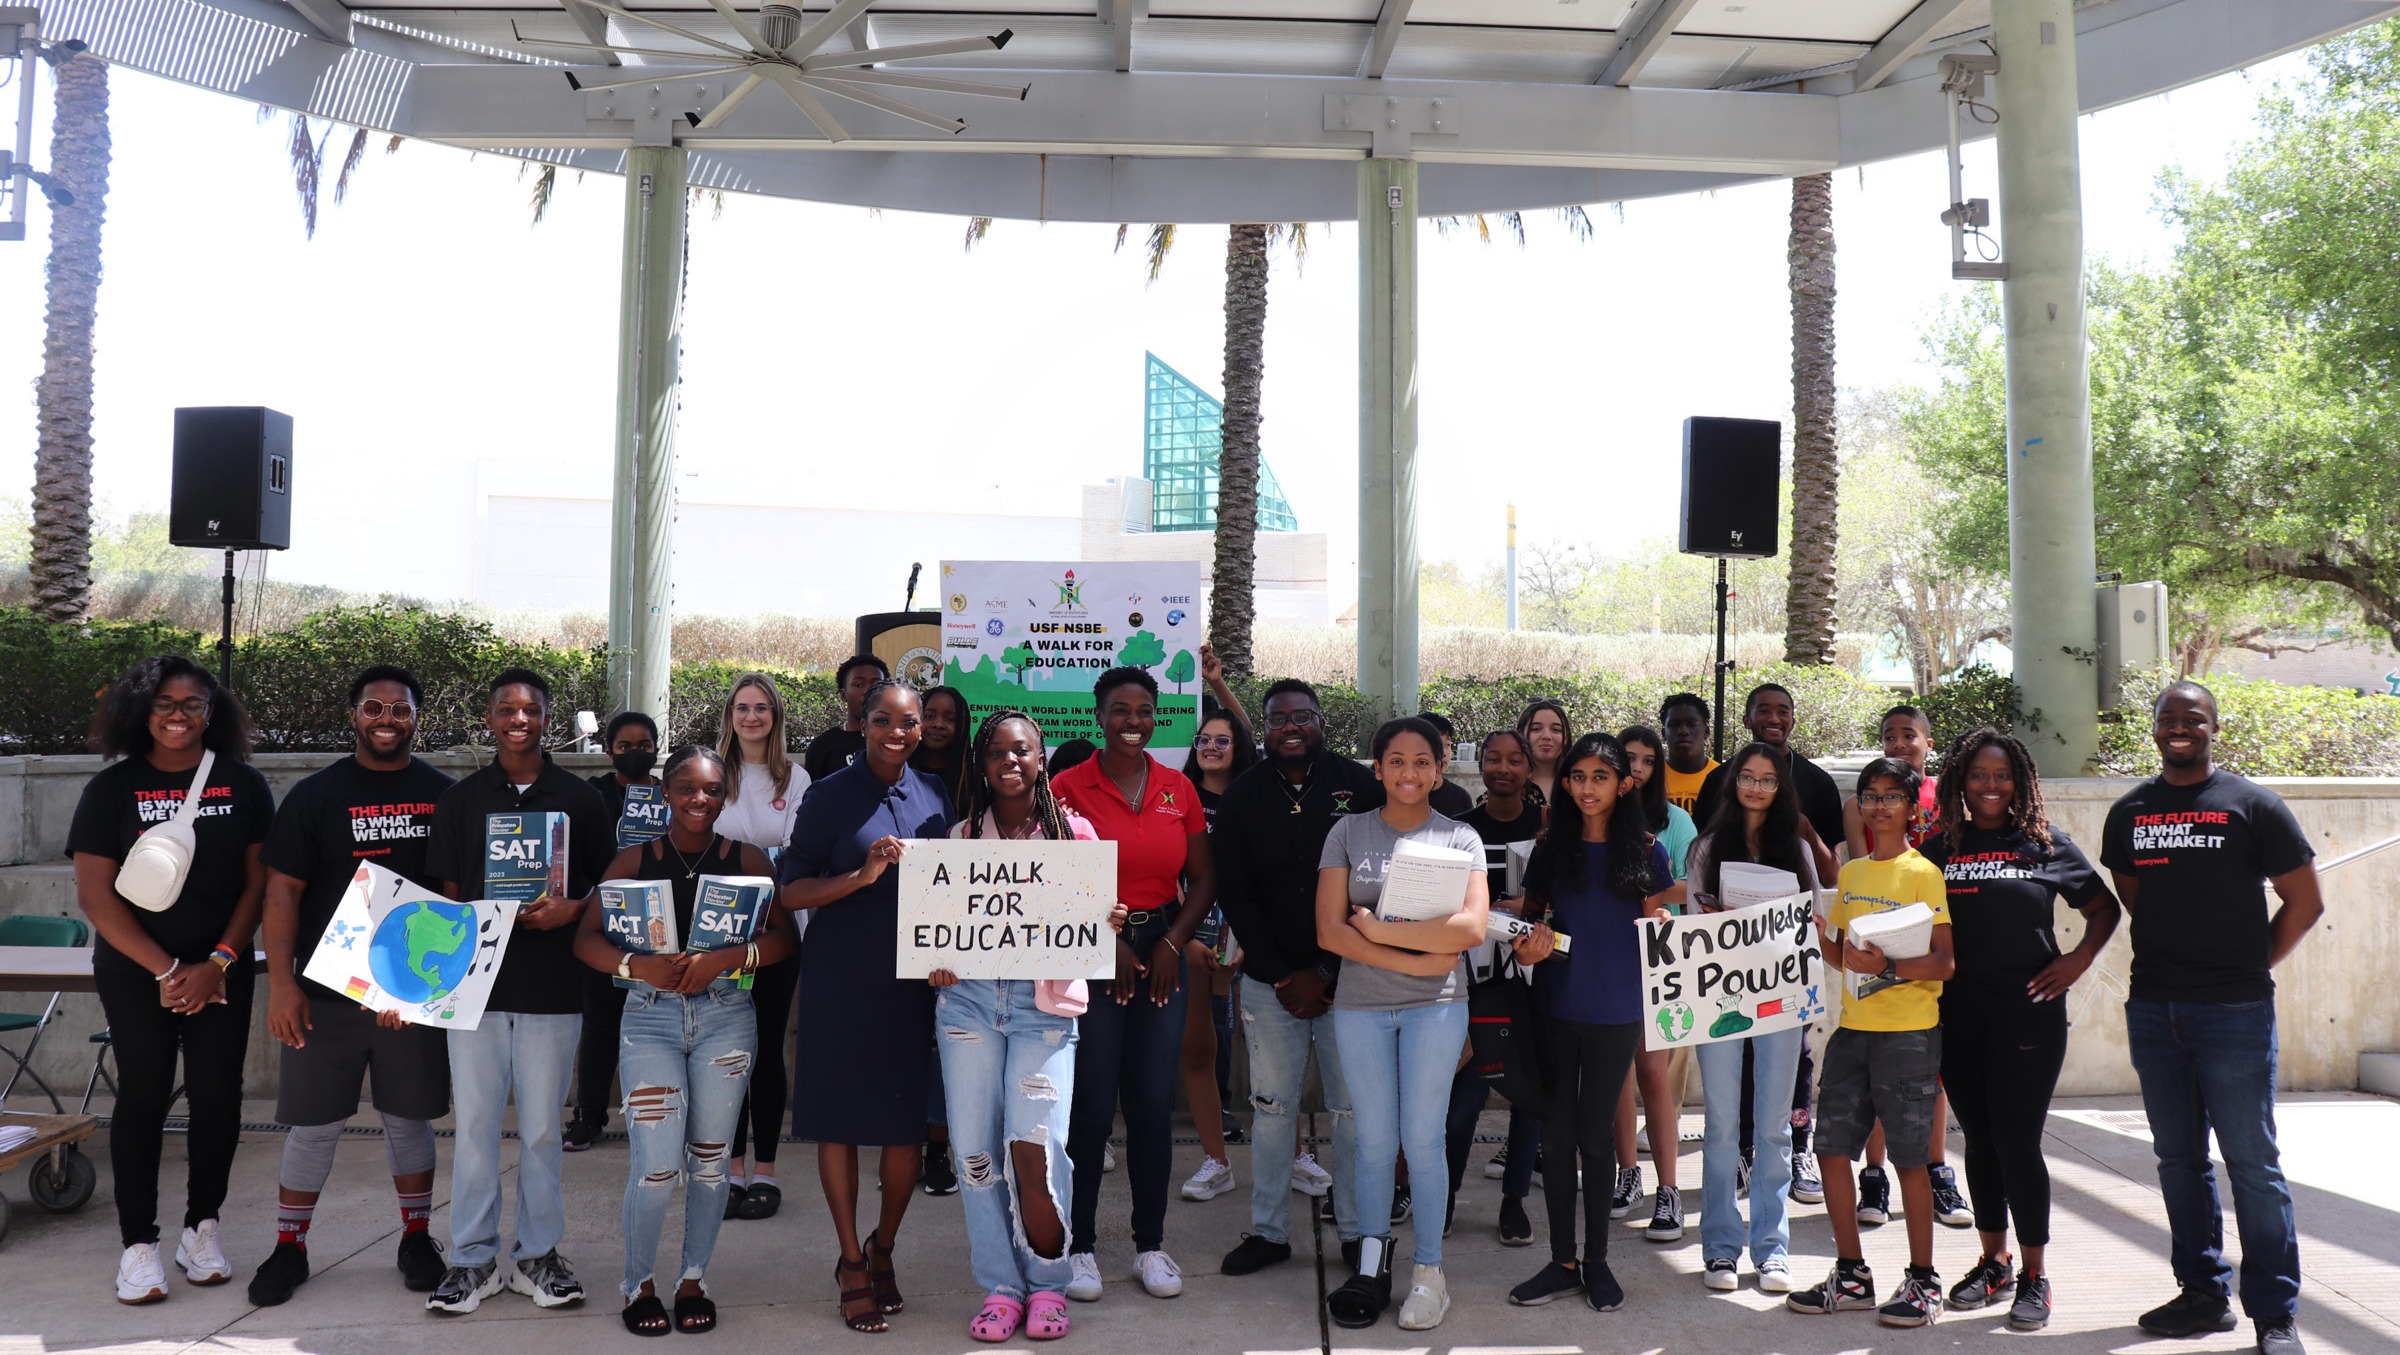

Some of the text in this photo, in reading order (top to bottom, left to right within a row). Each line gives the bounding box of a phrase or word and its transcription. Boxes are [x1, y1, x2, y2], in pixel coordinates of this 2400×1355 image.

[1169, 596, 1191, 604] IEEE
[1030, 623, 1102, 634] USF NSBE
[1023, 640, 1113, 651] A WALK FOR
[1025, 657, 1111, 668] EDUCATION
[1031, 706, 1068, 715] WORLD
[1071, 707, 1081, 715] IN
[1155, 707, 1195, 715] EERING
[1062, 719, 1093, 727] WORD
[1080, 731, 1093, 739] OF
[134, 787, 232, 801] THE FUURE
[138, 801, 154, 812] IS
[139, 809, 167, 822] WE
[218, 804, 234, 815] IT
[348, 805, 381, 818] THE
[625, 802, 664, 819] SAT
[351, 814, 413, 830] IS WHAT
[645, 818, 663, 827] Prep
[2134, 811, 2229, 827] THE FUTURE
[352, 828, 379, 842] WE
[381, 825, 426, 840] MAKE
[2133, 823, 2193, 839] IS WHAT
[2133, 834, 2225, 850] WE MAKE IT
[352, 847, 391, 857] Honeywell
[489, 839, 541, 861] SAT
[1947, 851, 2017, 864] THE FUTU
[517, 860, 543, 870] Prep
[1944, 860, 2005, 873] IS WHAT
[932, 861, 1044, 886] A WALK
[1943, 871, 1967, 880] WE
[1968, 868, 2017, 881] MAKE
[967, 892, 1024, 917] FOR
[1842, 891, 1901, 908] Champion
[607, 914, 642, 935] ACT
[697, 909, 749, 935] SAT
[1203, 918, 1217, 927] rep
[1507, 920, 1535, 939] SA
[1646, 899, 1813, 969] Knowledge
[625, 934, 645, 945] Prep
[723, 933, 744, 945] Prep
[914, 922, 1098, 951] EDUCATION
[693, 940, 710, 948] 2023
[1649, 946, 1821, 1006] is Power
